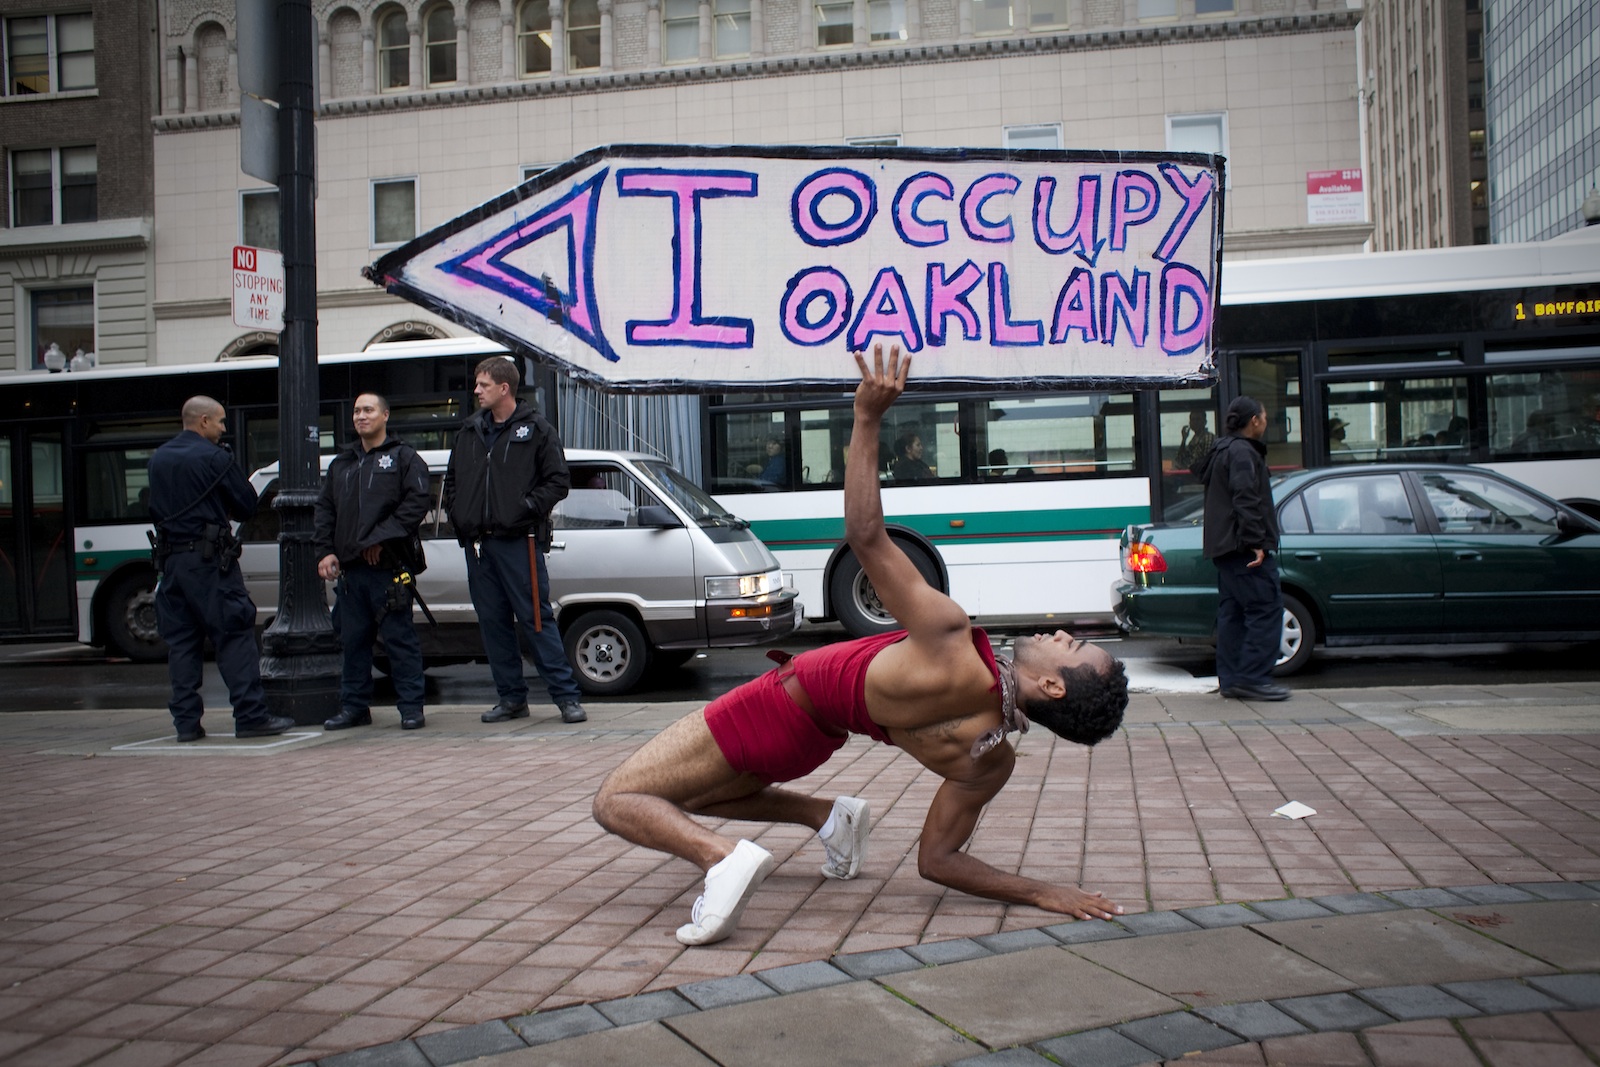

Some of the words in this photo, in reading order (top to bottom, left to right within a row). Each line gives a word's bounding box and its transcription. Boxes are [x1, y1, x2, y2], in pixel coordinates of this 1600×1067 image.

[1318, 184, 1352, 193] Available
[237, 249, 254, 269] NO
[616, 168, 758, 348] I
[791, 163, 1214, 267] OCCUPY
[235, 273, 282, 294] STOPPING
[250, 293, 268, 305] ANY
[780, 259, 1210, 356] OAKLAND
[250, 307, 269, 320] TIME
[1515, 302, 1526, 320] 1
